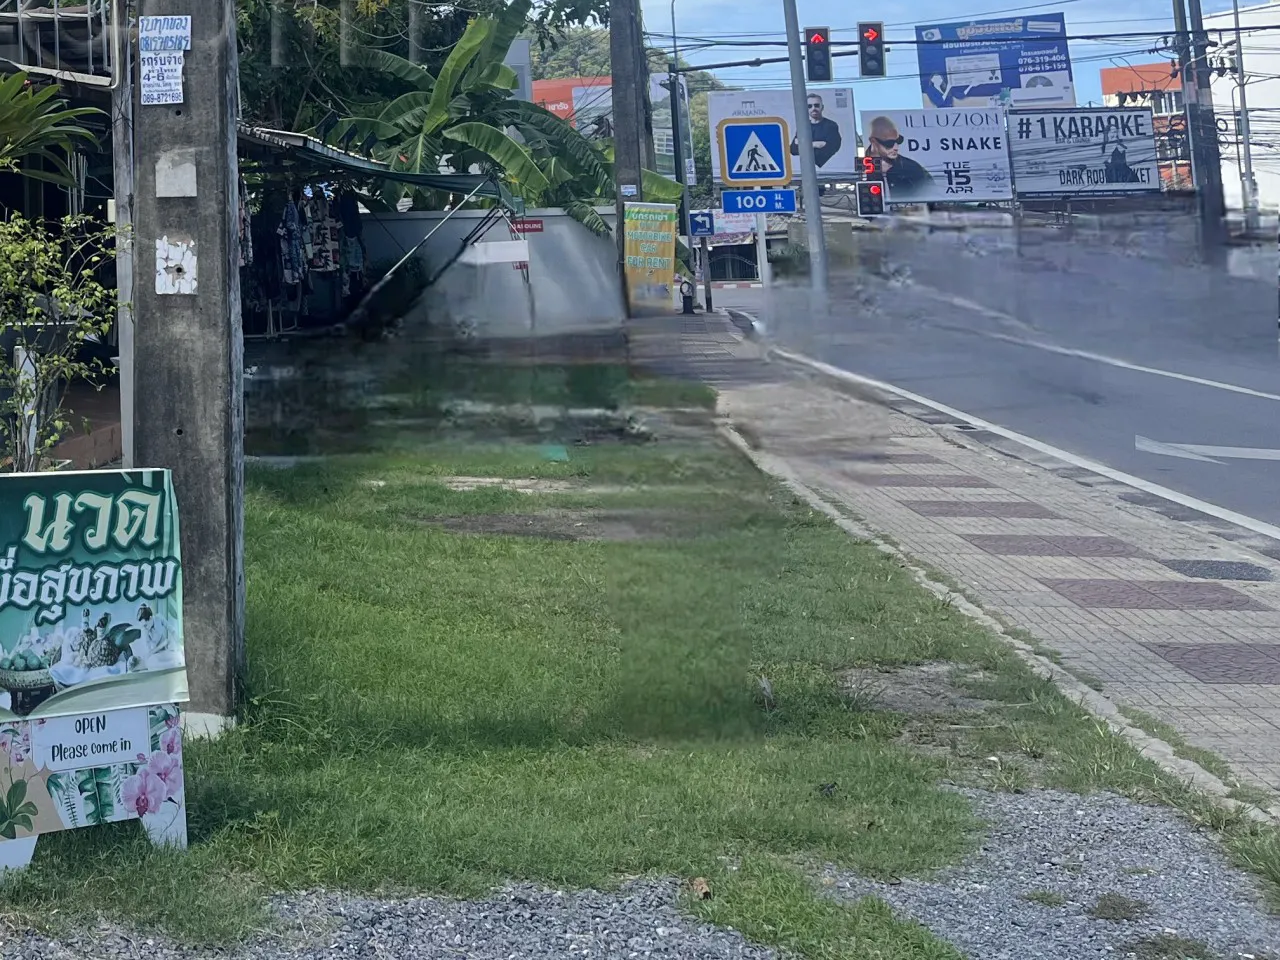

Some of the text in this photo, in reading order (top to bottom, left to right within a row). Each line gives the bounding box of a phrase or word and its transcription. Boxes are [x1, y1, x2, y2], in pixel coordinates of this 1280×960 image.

[904, 112, 999, 128] ILLUZION
[1053, 114, 1147, 138] KARAOKE
[908, 136, 1002, 152] DJ SNAKE
[943, 161, 970, 169] TUE
[943, 169, 971, 186] 15
[1059, 169, 1085, 185] DARK
[1086, 168, 1111, 185] ROO
[945, 186, 974, 194] APR
[736, 195, 767, 209] 100
[627, 256, 671, 269] FOR RENT
[23, 490, 161, 554] นวด
[74, 714, 107, 735] OPEN
[51, 738, 132, 762] Please come in
